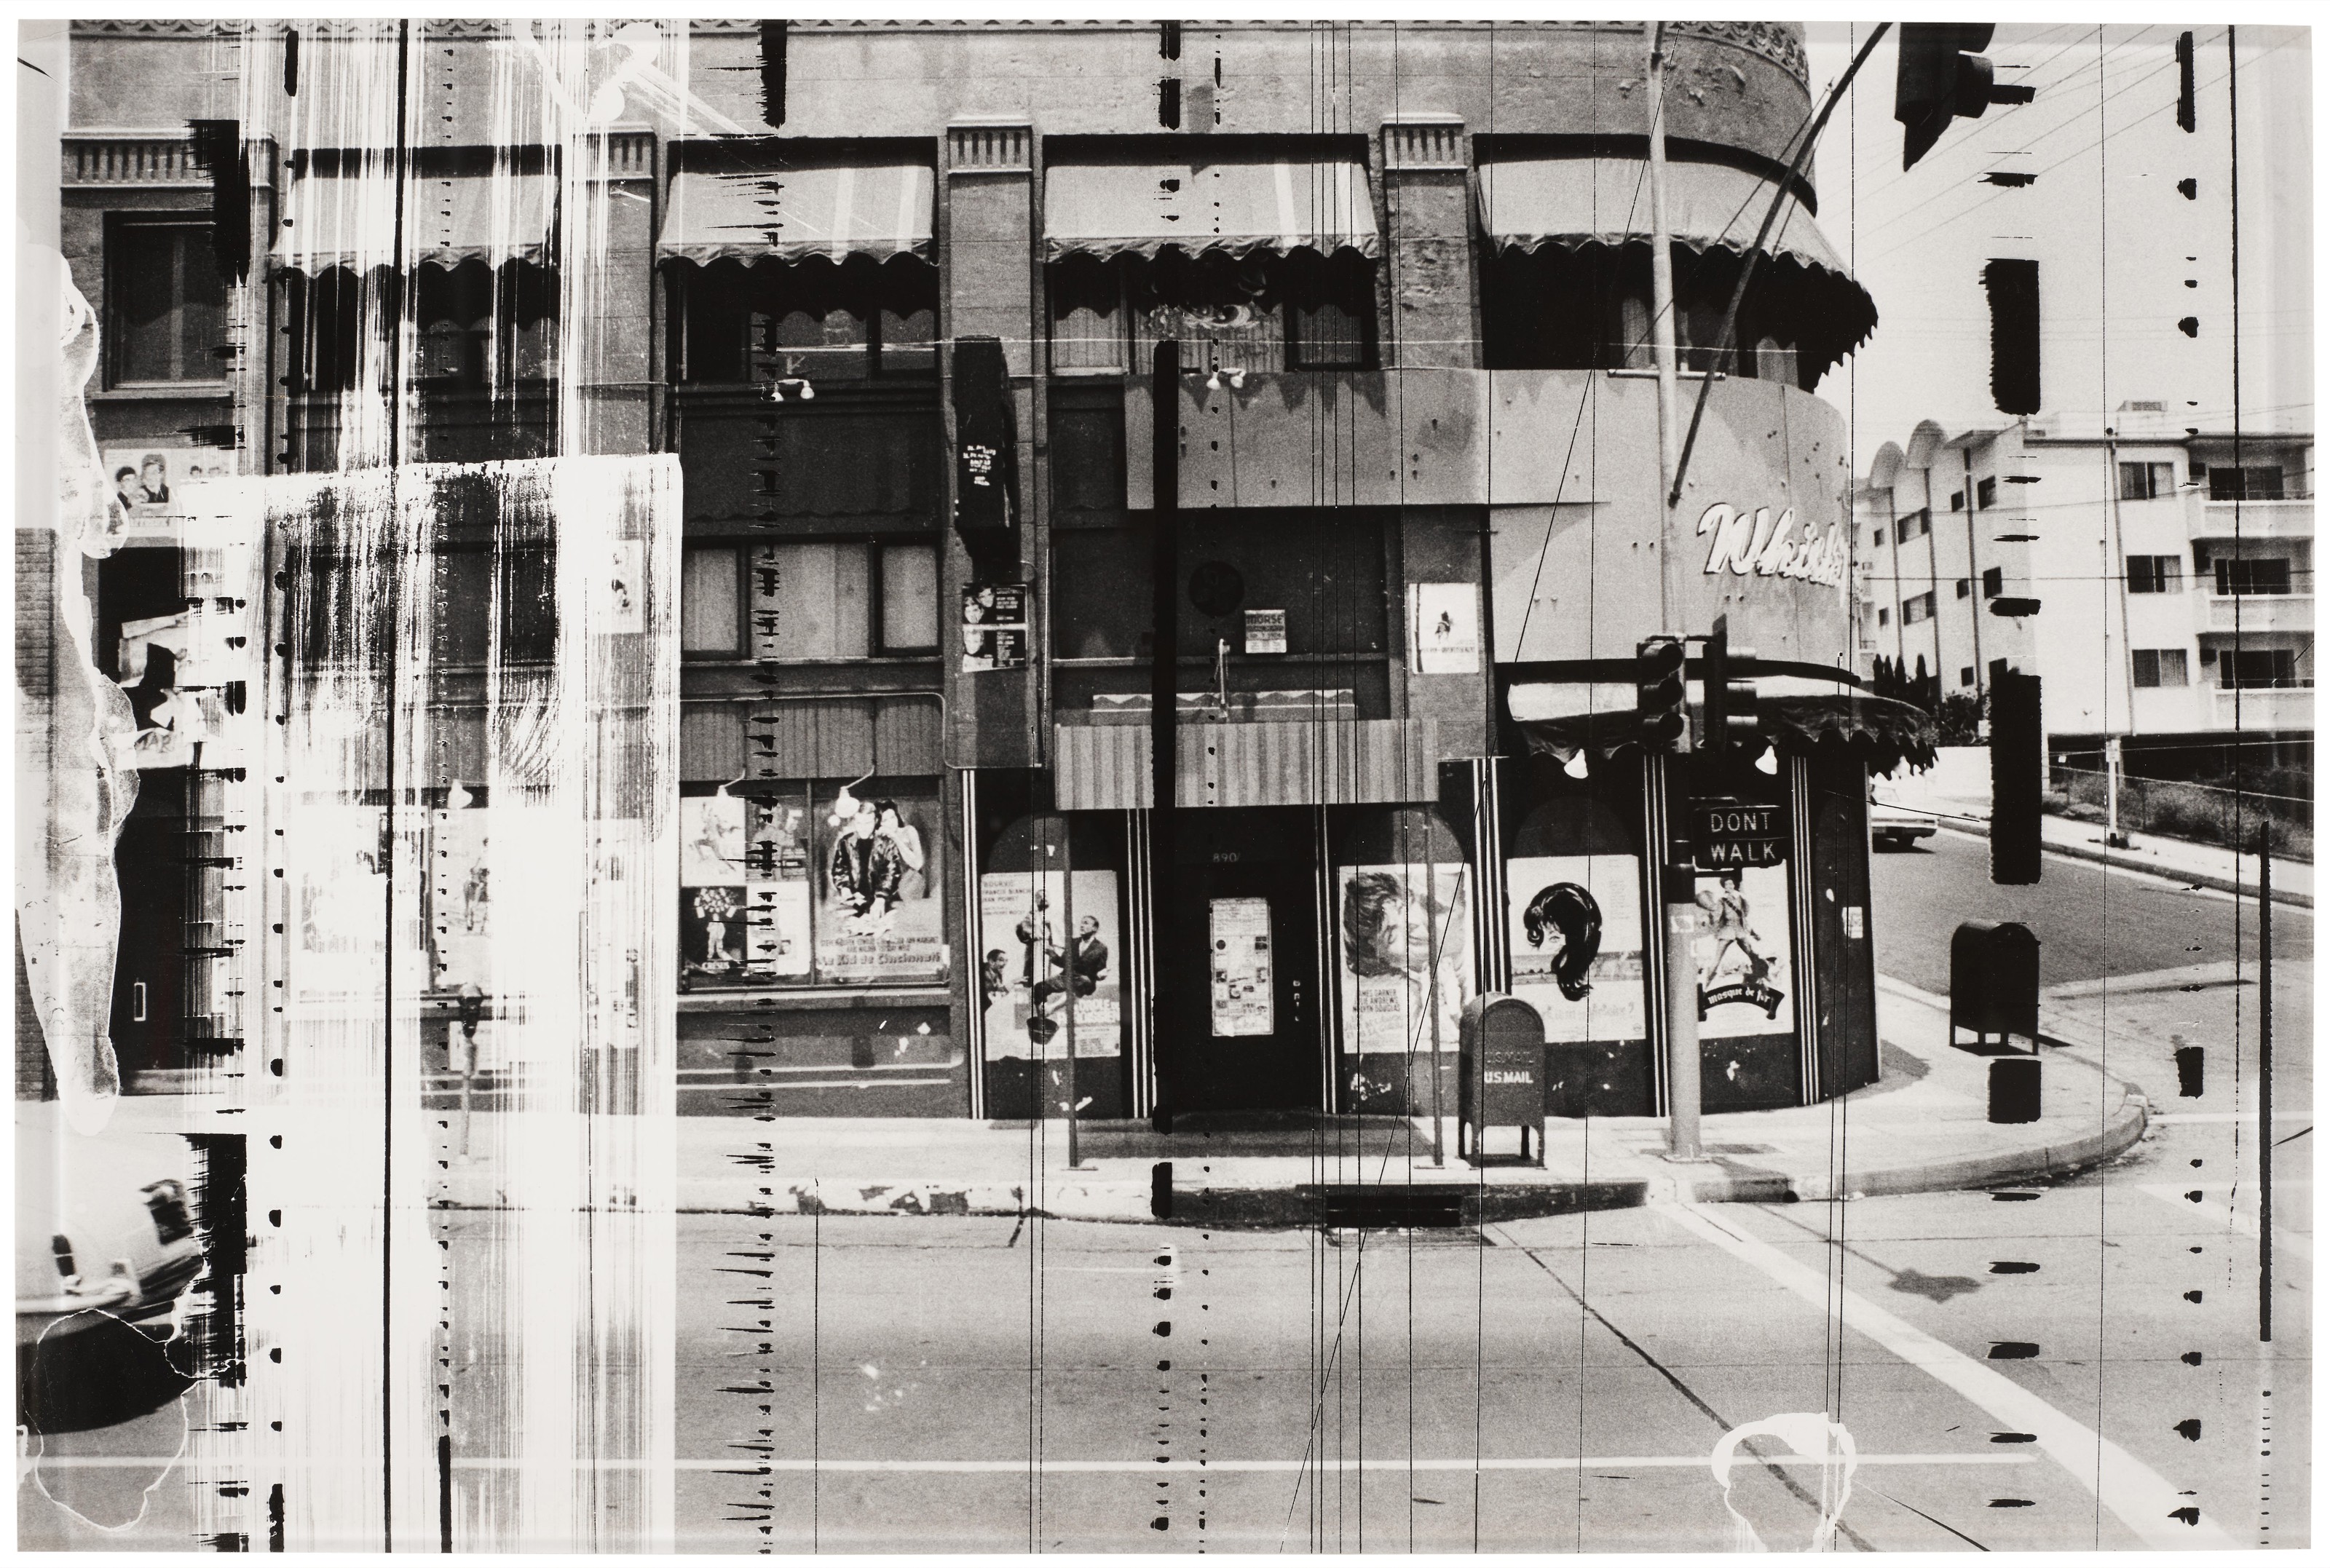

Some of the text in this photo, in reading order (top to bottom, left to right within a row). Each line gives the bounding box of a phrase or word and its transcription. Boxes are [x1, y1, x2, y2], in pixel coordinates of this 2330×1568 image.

[1710, 812, 1771, 833] DONT
[1710, 841, 1777, 862] WALK
[1503, 1070, 1534, 1084] MAIL
